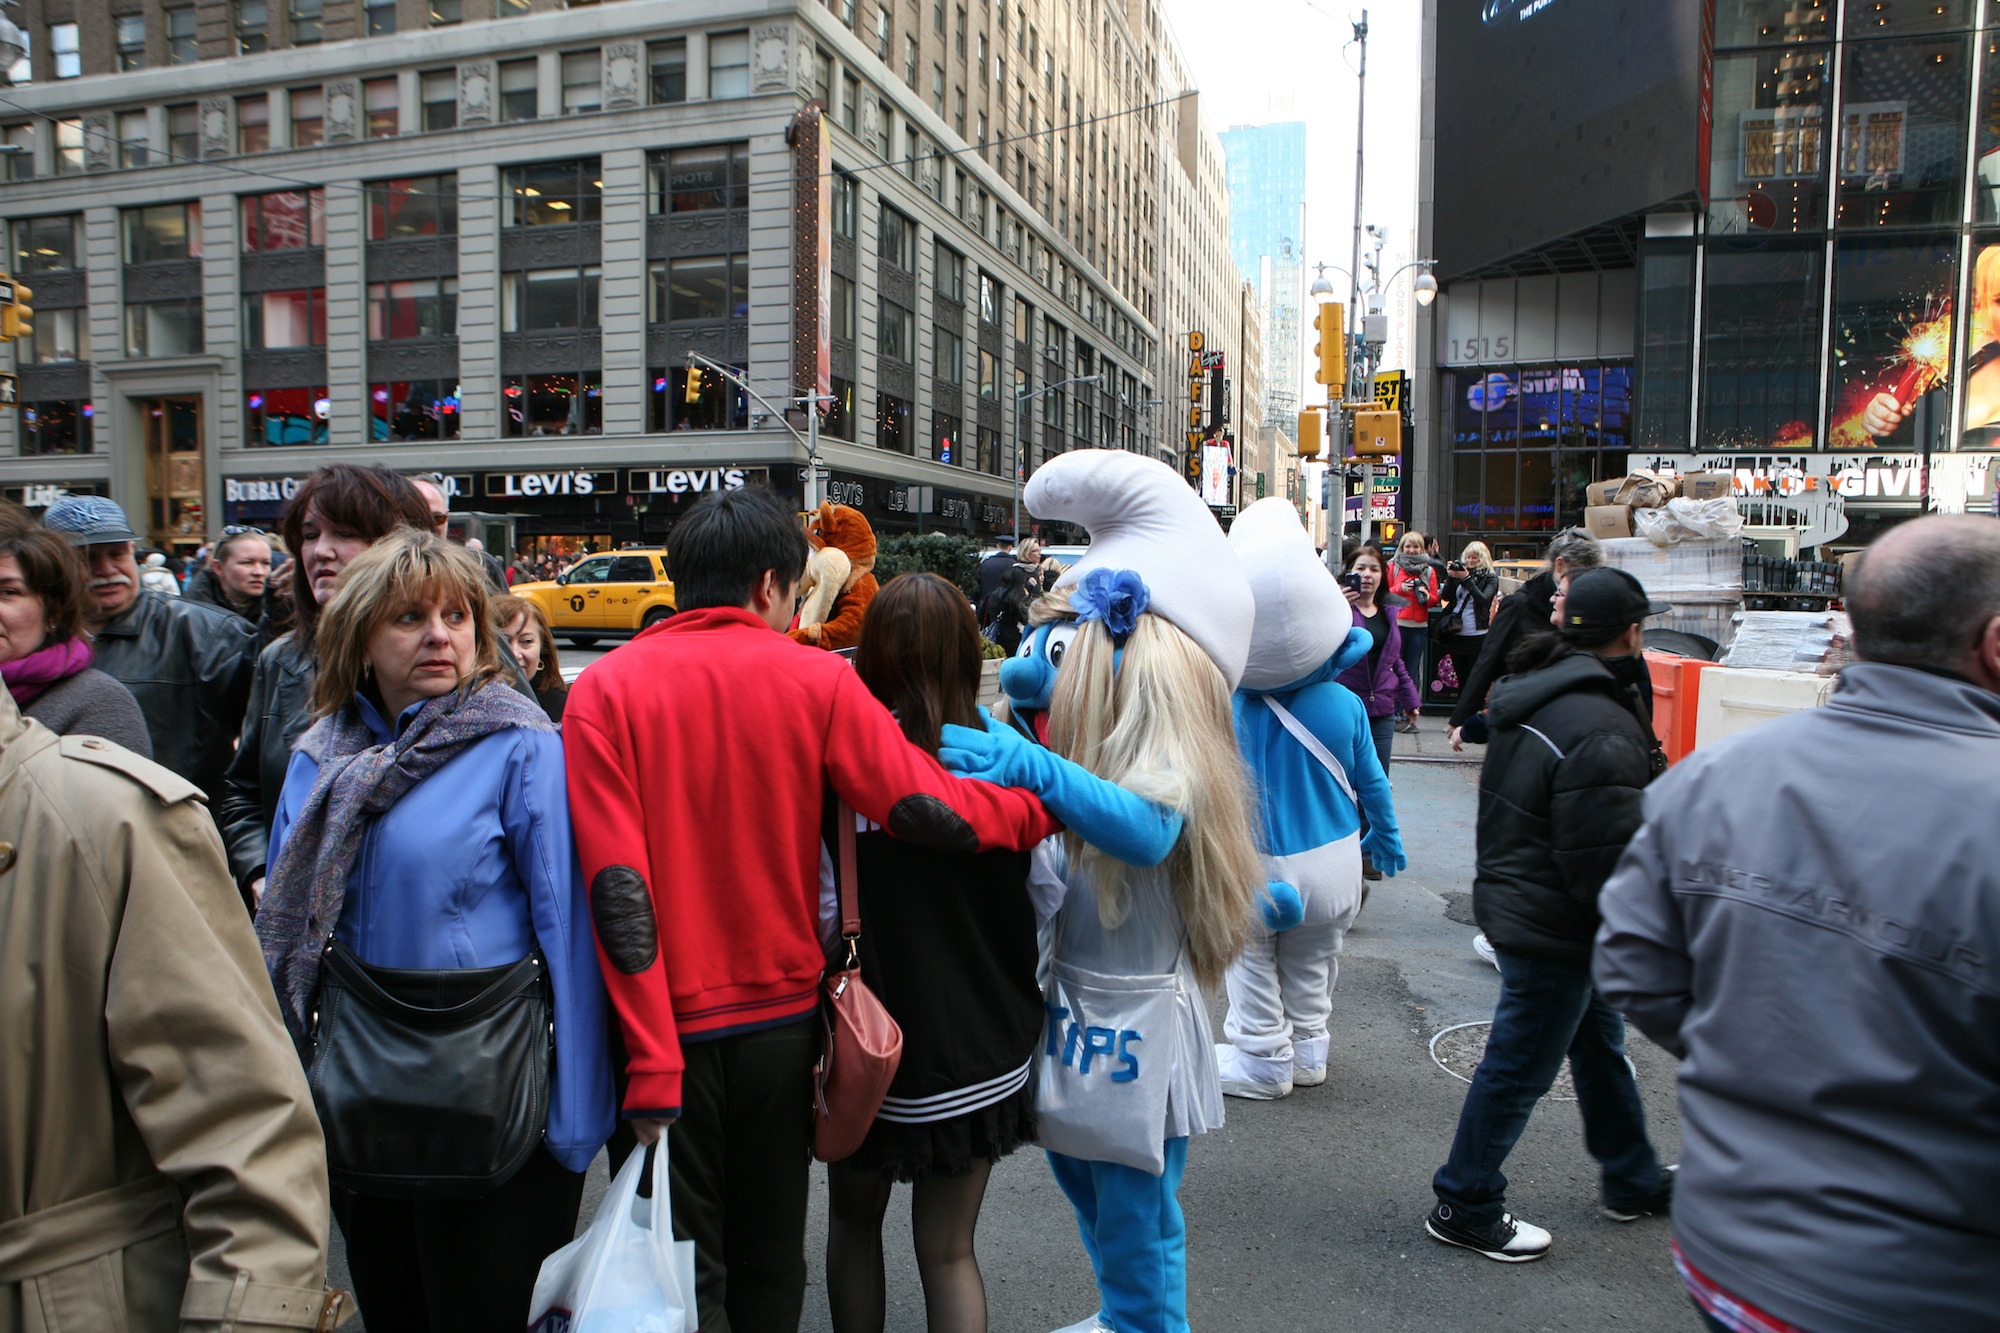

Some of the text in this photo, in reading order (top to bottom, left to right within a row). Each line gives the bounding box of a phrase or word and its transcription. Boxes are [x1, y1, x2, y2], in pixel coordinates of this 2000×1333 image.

[1519, 3, 1533, 21] THE
[1451, 336, 1509, 360] 1515
[1188, 331, 1204, 476] DAFFY'S
[225, 479, 281, 502] BUBBA
[1733, 476, 1846, 491] AKLEY
[1836, 468, 1985, 497] GIVN
[1043, 1001, 1142, 1083] TIPS
